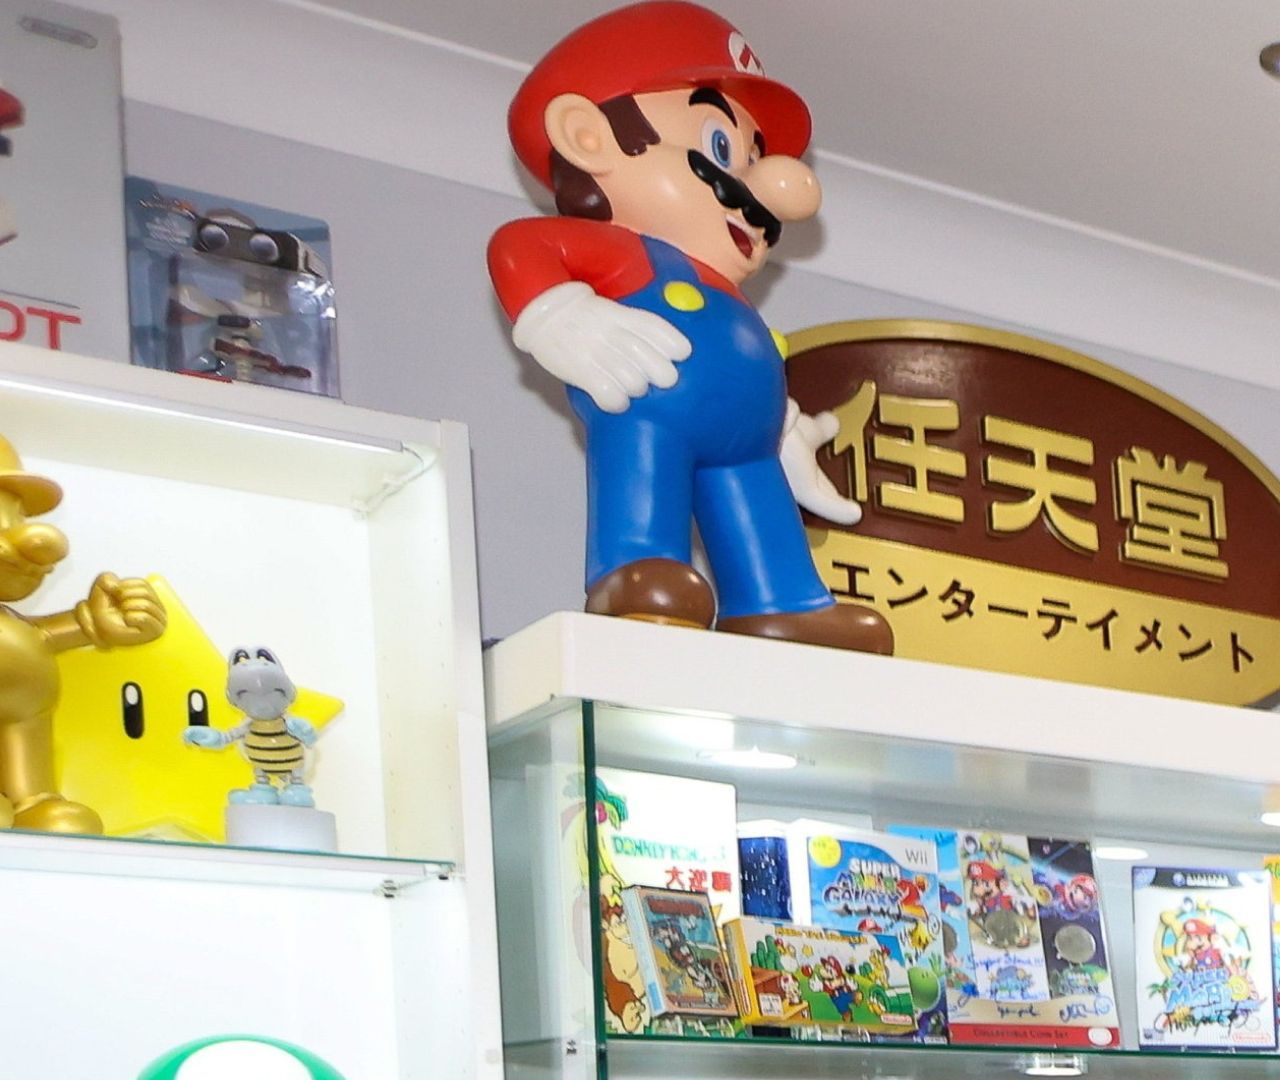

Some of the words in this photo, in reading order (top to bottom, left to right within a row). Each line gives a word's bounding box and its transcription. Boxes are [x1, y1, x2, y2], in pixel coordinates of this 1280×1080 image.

[826, 380, 1229, 579] 任天堂
[830, 560, 1254, 674] エンターテイメント
[904, 849, 929, 866] Wii
